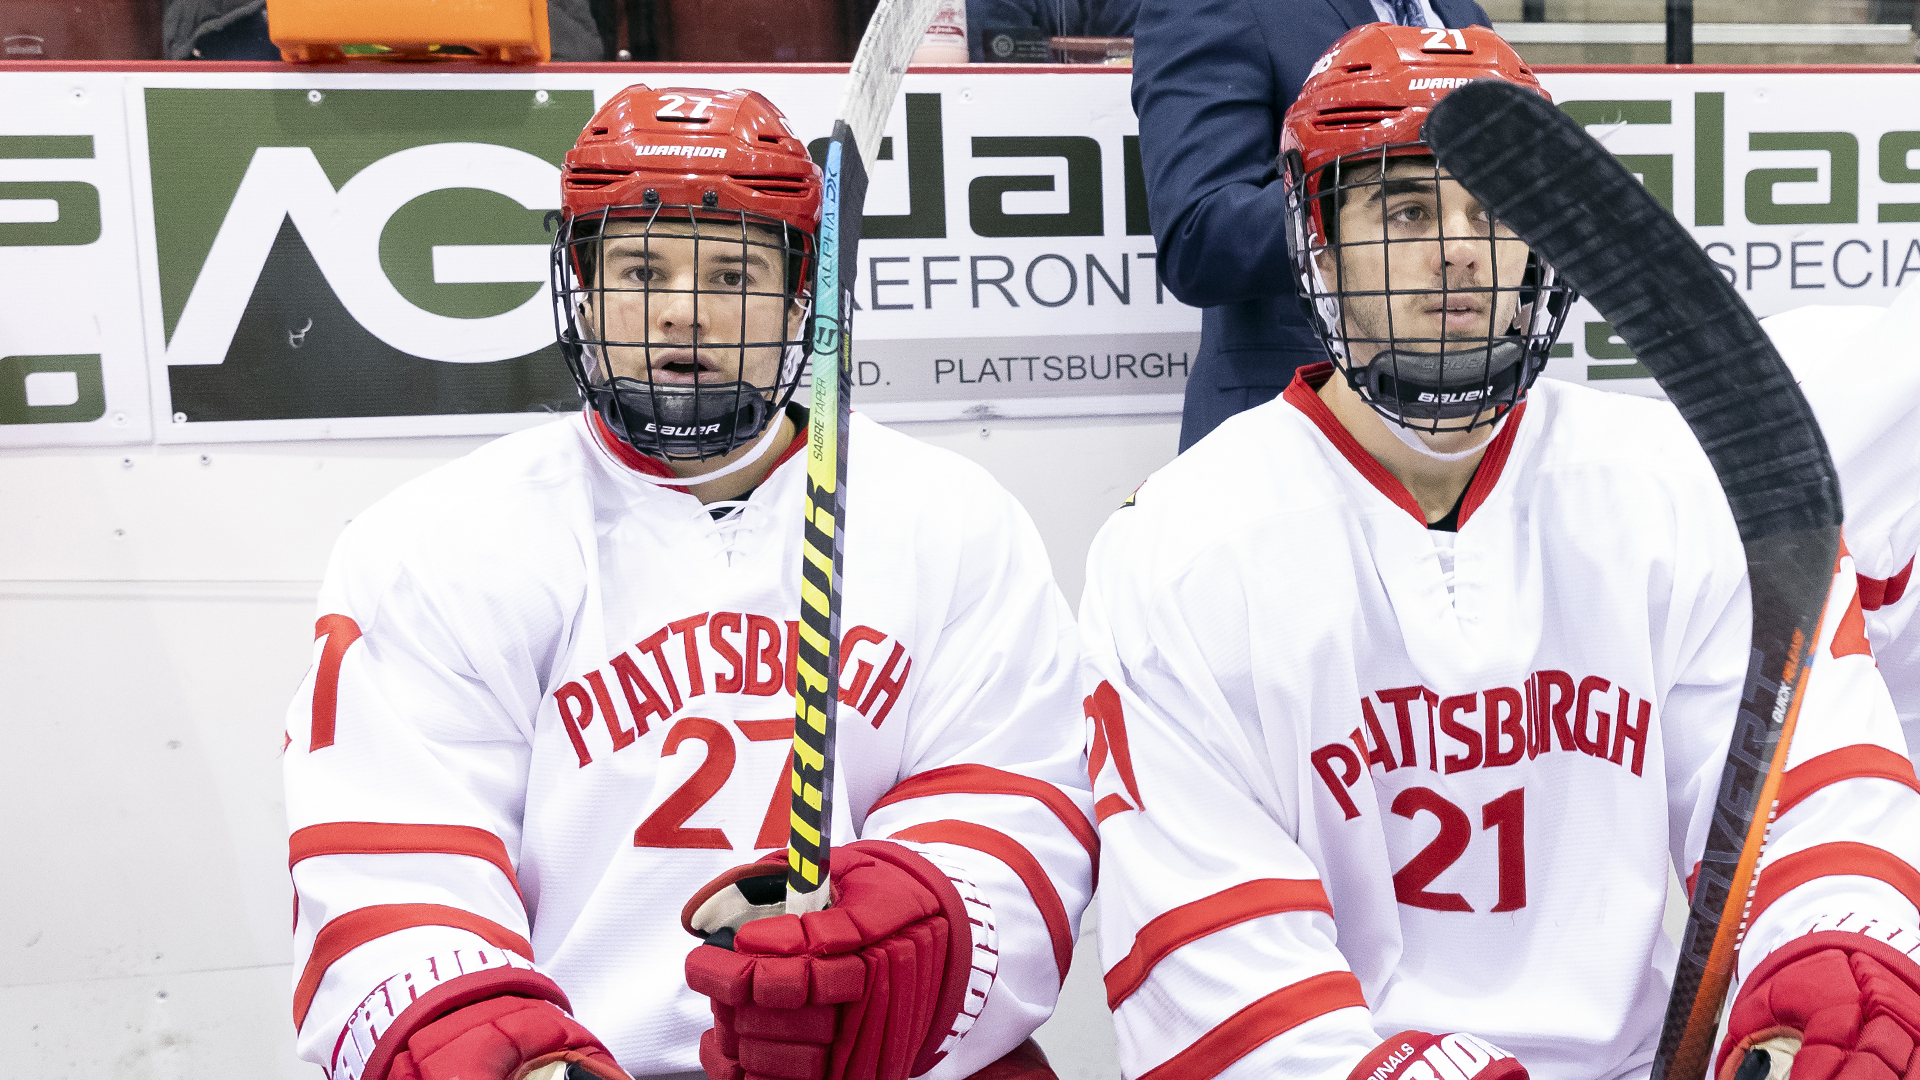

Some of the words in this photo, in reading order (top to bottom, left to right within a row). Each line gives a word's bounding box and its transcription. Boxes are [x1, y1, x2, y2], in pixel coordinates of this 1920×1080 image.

[1420, 28, 1467, 50] 21
[1408, 77, 1473, 91] WARR
[656, 94, 714, 119] 27
[635, 145, 728, 159] WARRIOR
[826, 167, 838, 203] DX
[166, 142, 564, 364] AG
[822, 212, 836, 288] ALPHA
[934, 352, 1190, 384] PLATTSBURGH
[815, 377, 827, 419] TAPER
[1417, 385, 1494, 403] BAUER
[644, 422, 721, 437] BAUER
[813, 421, 825, 462] SABRE
[300, 612, 364, 754] 7
[1771, 680, 1792, 724] QUICK
[1082, 679, 1146, 828] 21
[633, 716, 798, 851] 27
[1390, 786, 1528, 914] 21
